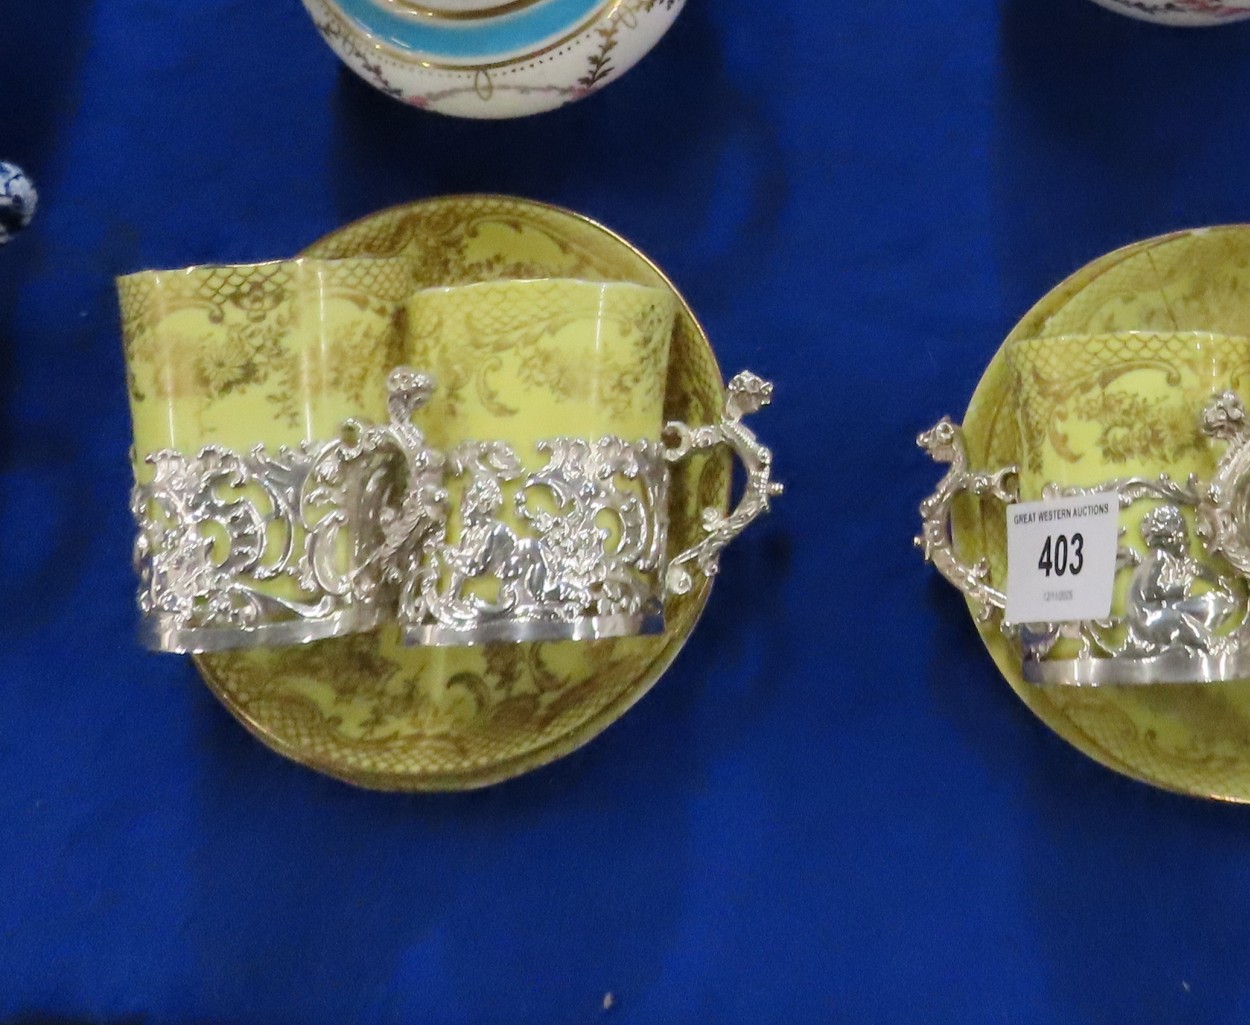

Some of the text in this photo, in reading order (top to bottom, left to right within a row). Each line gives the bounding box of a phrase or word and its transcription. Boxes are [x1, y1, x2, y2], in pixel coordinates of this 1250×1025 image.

[1014, 503, 1109, 525] GREAT WESTERN AUCTIONS
[1038, 532, 1084, 577] 403
